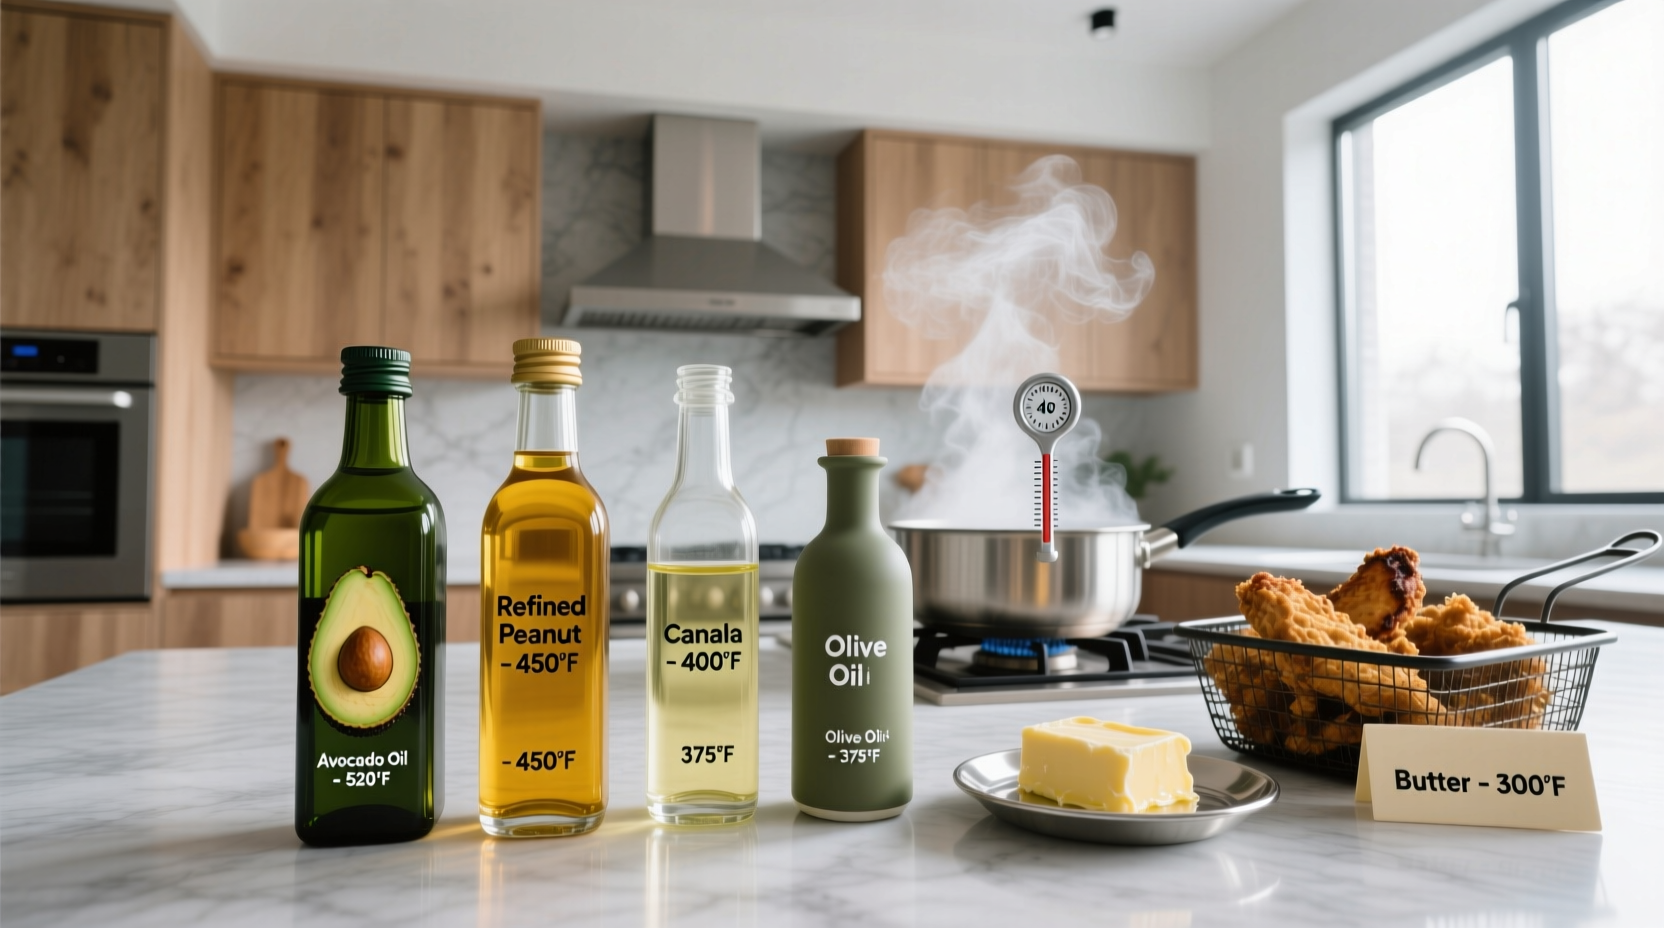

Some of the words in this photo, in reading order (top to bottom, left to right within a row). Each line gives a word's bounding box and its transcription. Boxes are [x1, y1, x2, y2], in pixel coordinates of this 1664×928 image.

[497, 595, 586, 616] Refined
[499, 624, 582, 644] Peanut
[664, 623, 743, 644] Canala
[825, 634, 887, 657] Olive
[825, 730, 862, 744] Olive
[317, 752, 384, 768] Avocado
[387, 750, 408, 766] Oil
[1394, 769, 1471, 793] Butter
